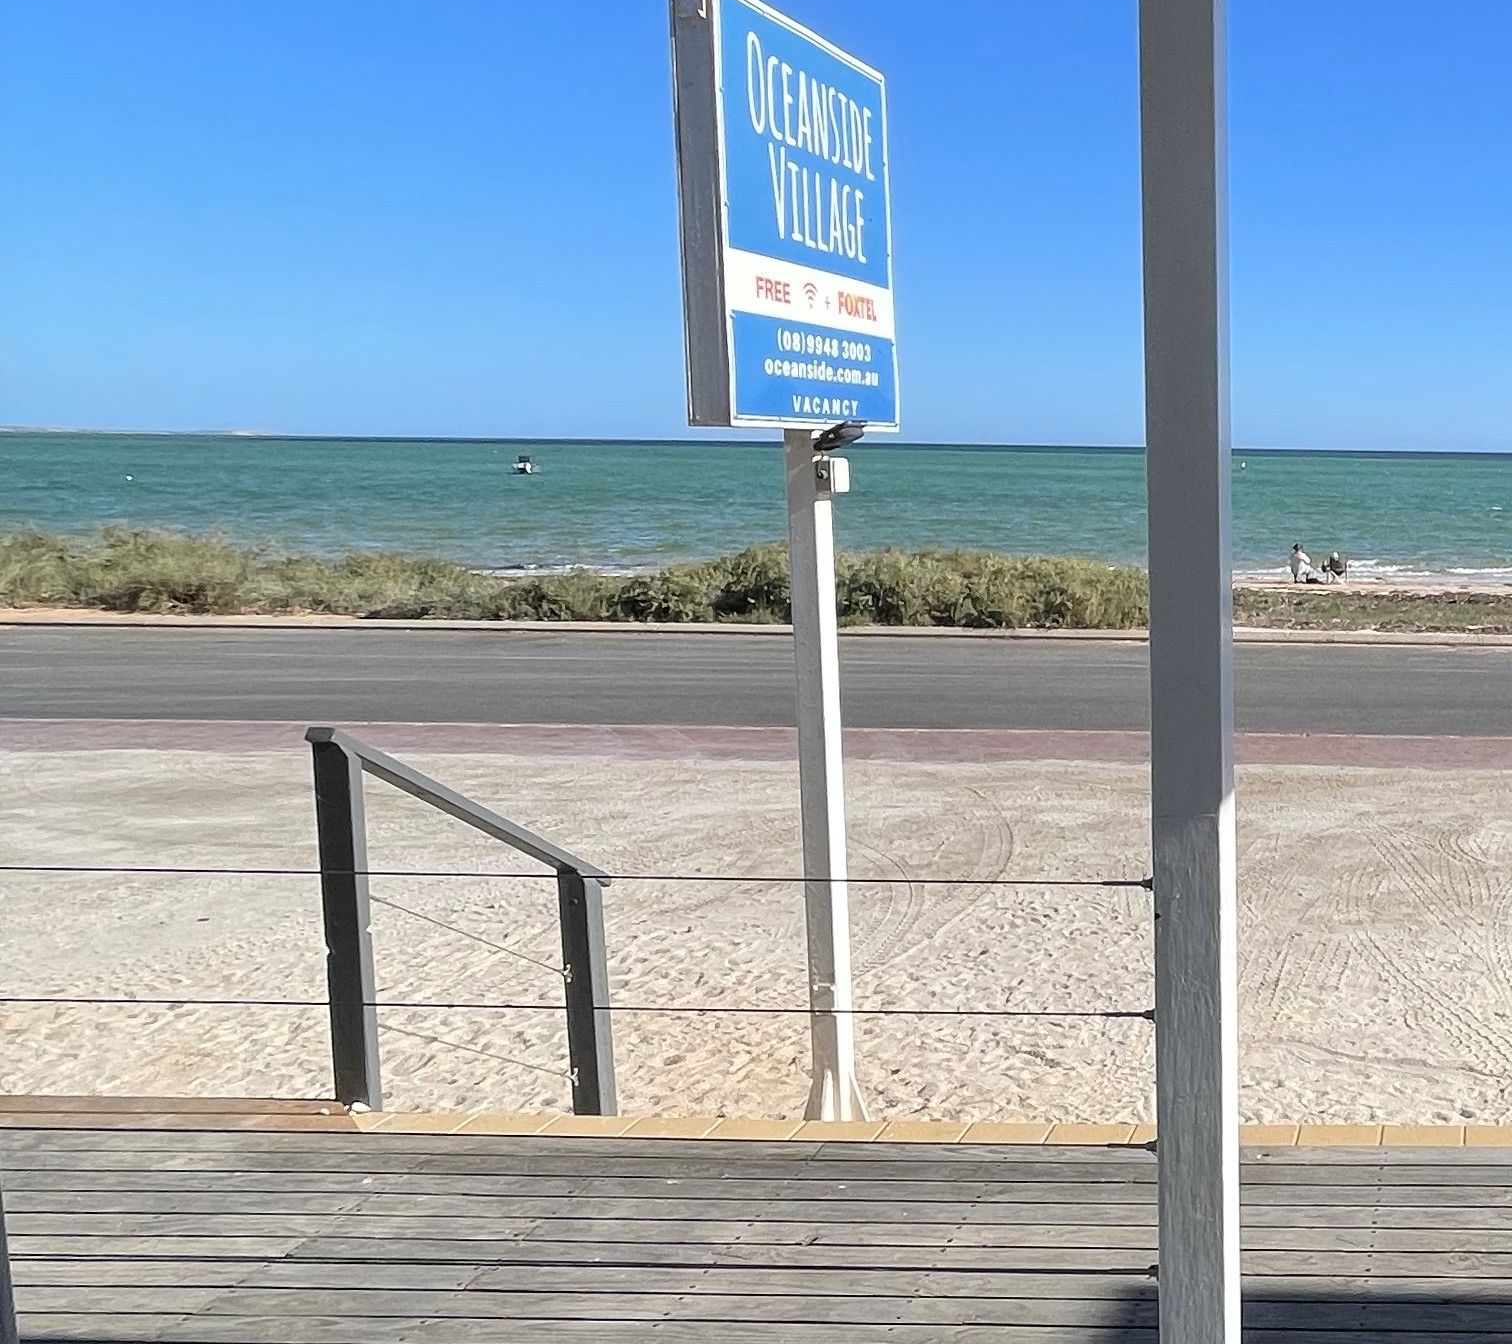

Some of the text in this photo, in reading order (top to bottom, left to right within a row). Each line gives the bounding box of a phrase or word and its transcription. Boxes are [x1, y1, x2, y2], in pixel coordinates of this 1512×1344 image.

[746, 30, 875, 182] OCEANSIDE
[768, 141, 867, 264] VILLAGE
[755, 276, 791, 304] FREE
[838, 290, 877, 322] FOXTEL
[763, 358, 879, 387] oceanside.com.au
[792, 394, 859, 416] VACANCY
